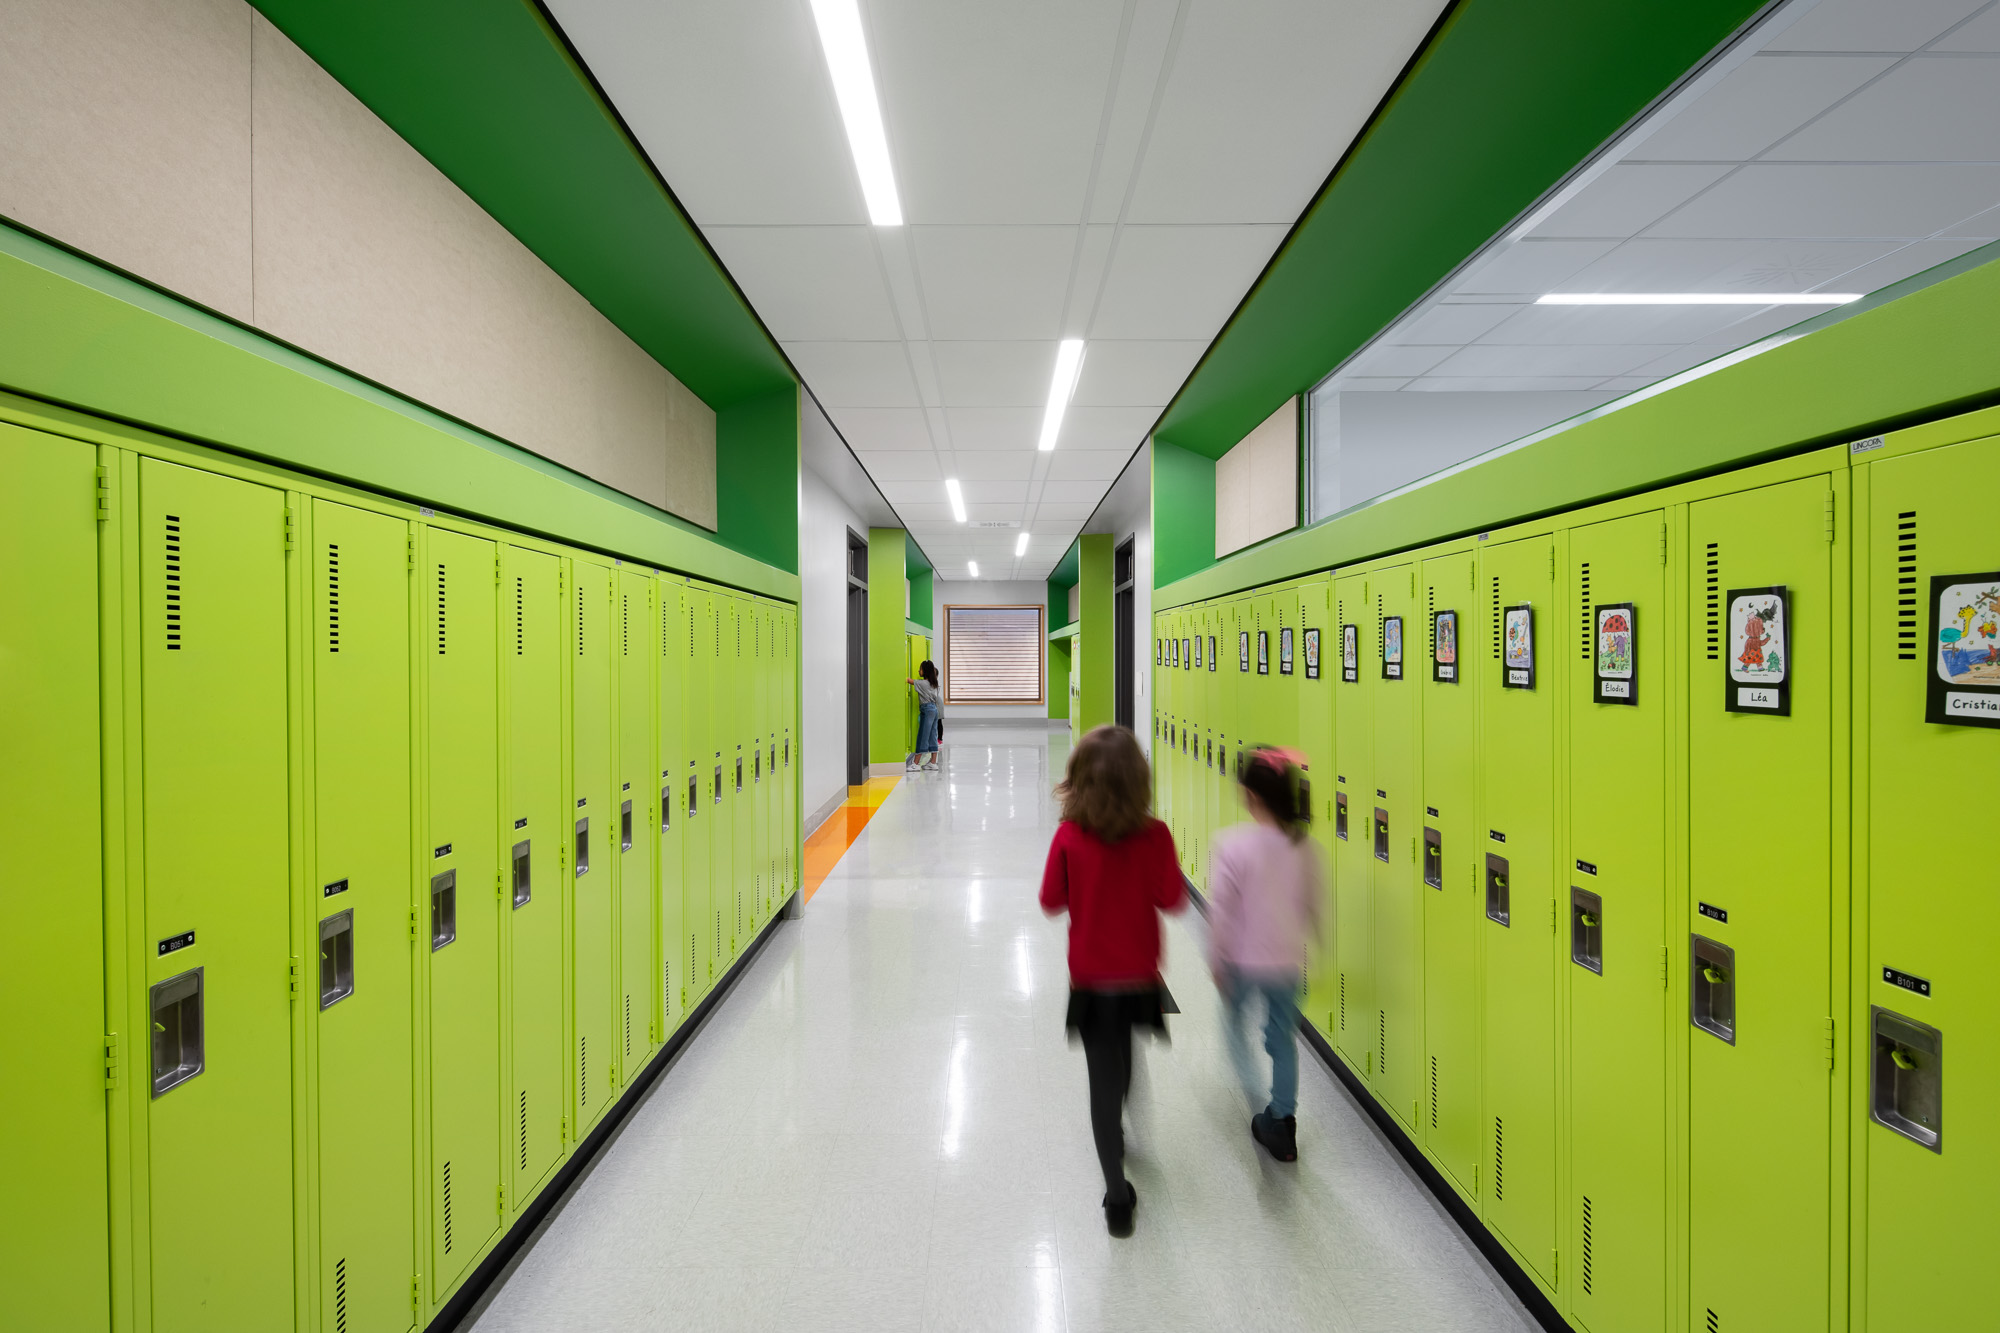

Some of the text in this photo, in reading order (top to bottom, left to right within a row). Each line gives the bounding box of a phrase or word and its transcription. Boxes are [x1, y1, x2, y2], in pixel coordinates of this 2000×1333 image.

[1605, 682, 1624, 693] Élodie
[1751, 692, 1768, 703] Léa
[1952, 698, 2000, 711] Cristia
[1897, 976, 1915, 990] B101
